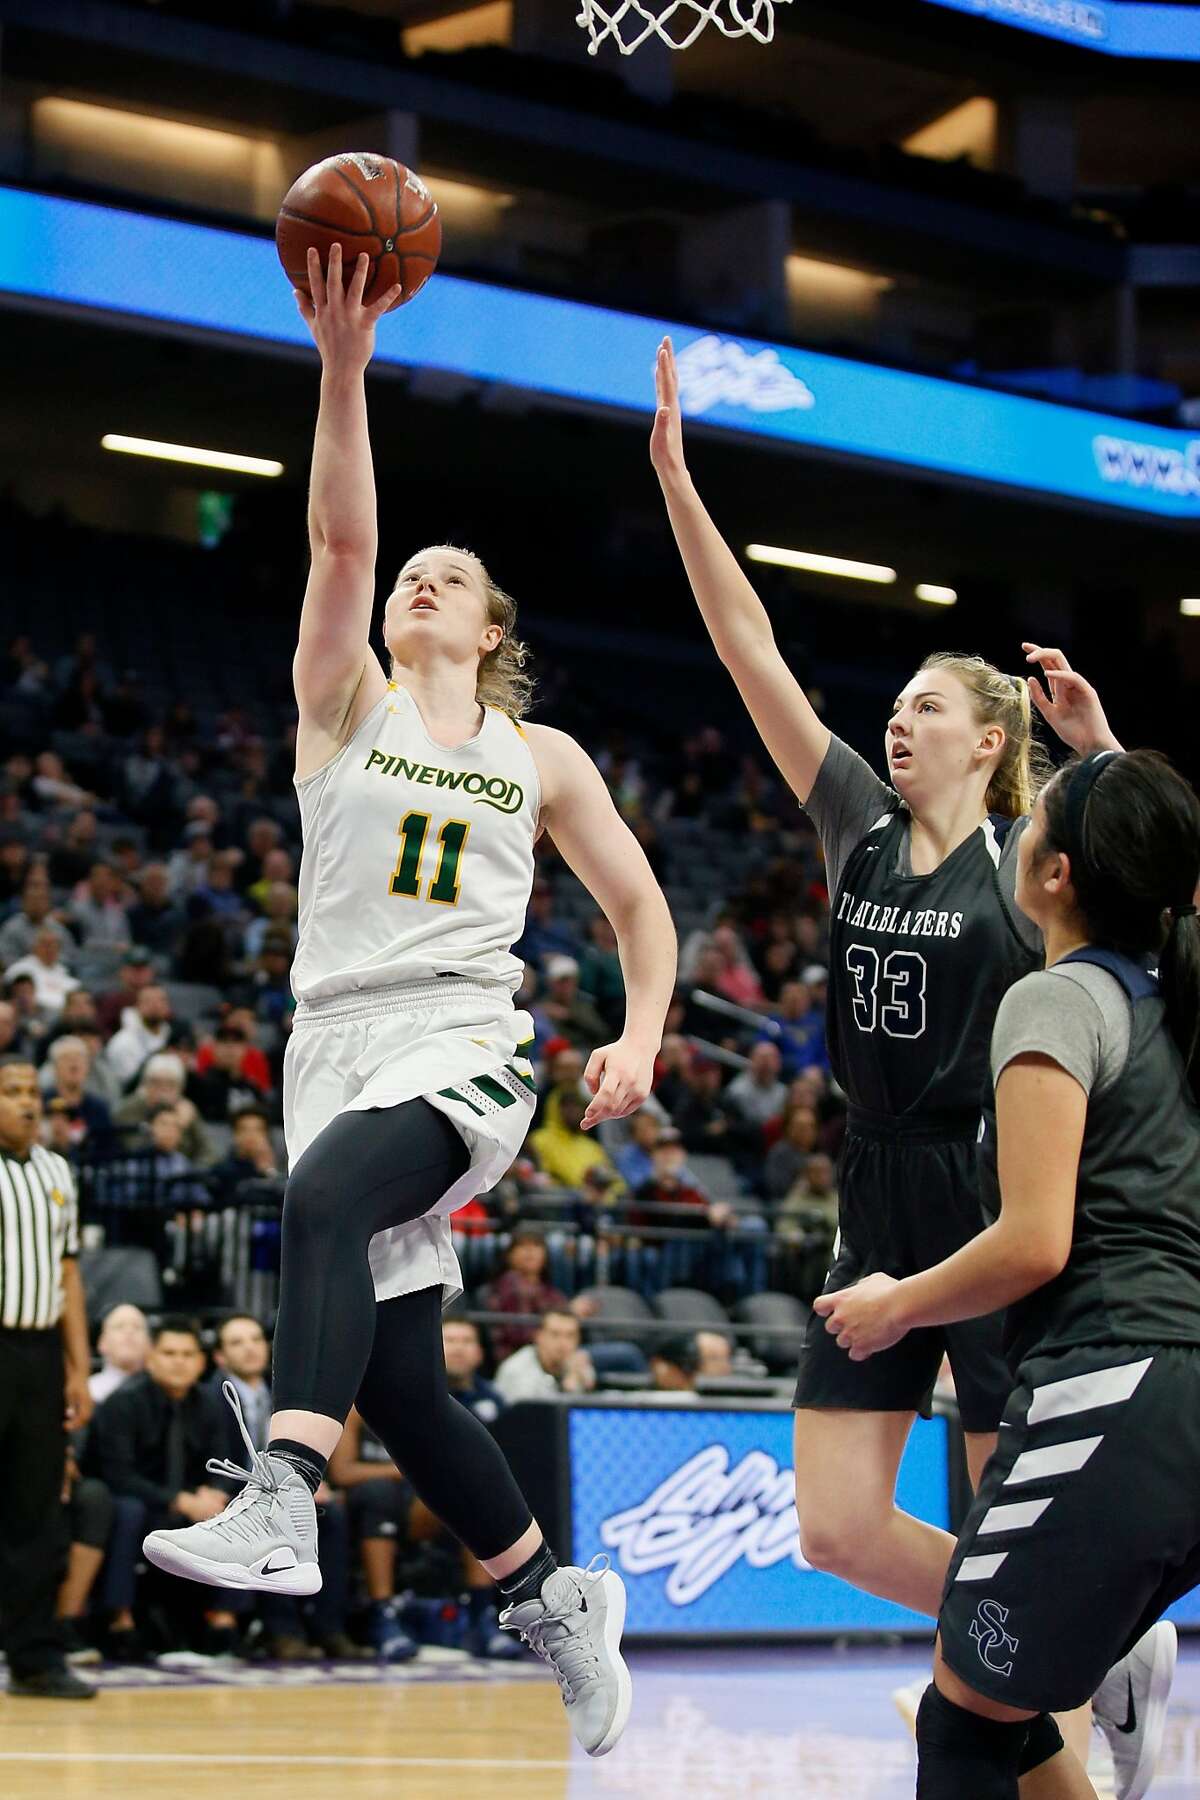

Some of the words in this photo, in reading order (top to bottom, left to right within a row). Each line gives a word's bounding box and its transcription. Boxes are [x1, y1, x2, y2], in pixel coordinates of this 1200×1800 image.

[364, 749, 524, 815] PINEWOOD
[389, 809, 471, 907] 11
[837, 892, 963, 939] TAILBLAZERS
[846, 943, 927, 1039] 33
[968, 1599, 1019, 1677] SC
